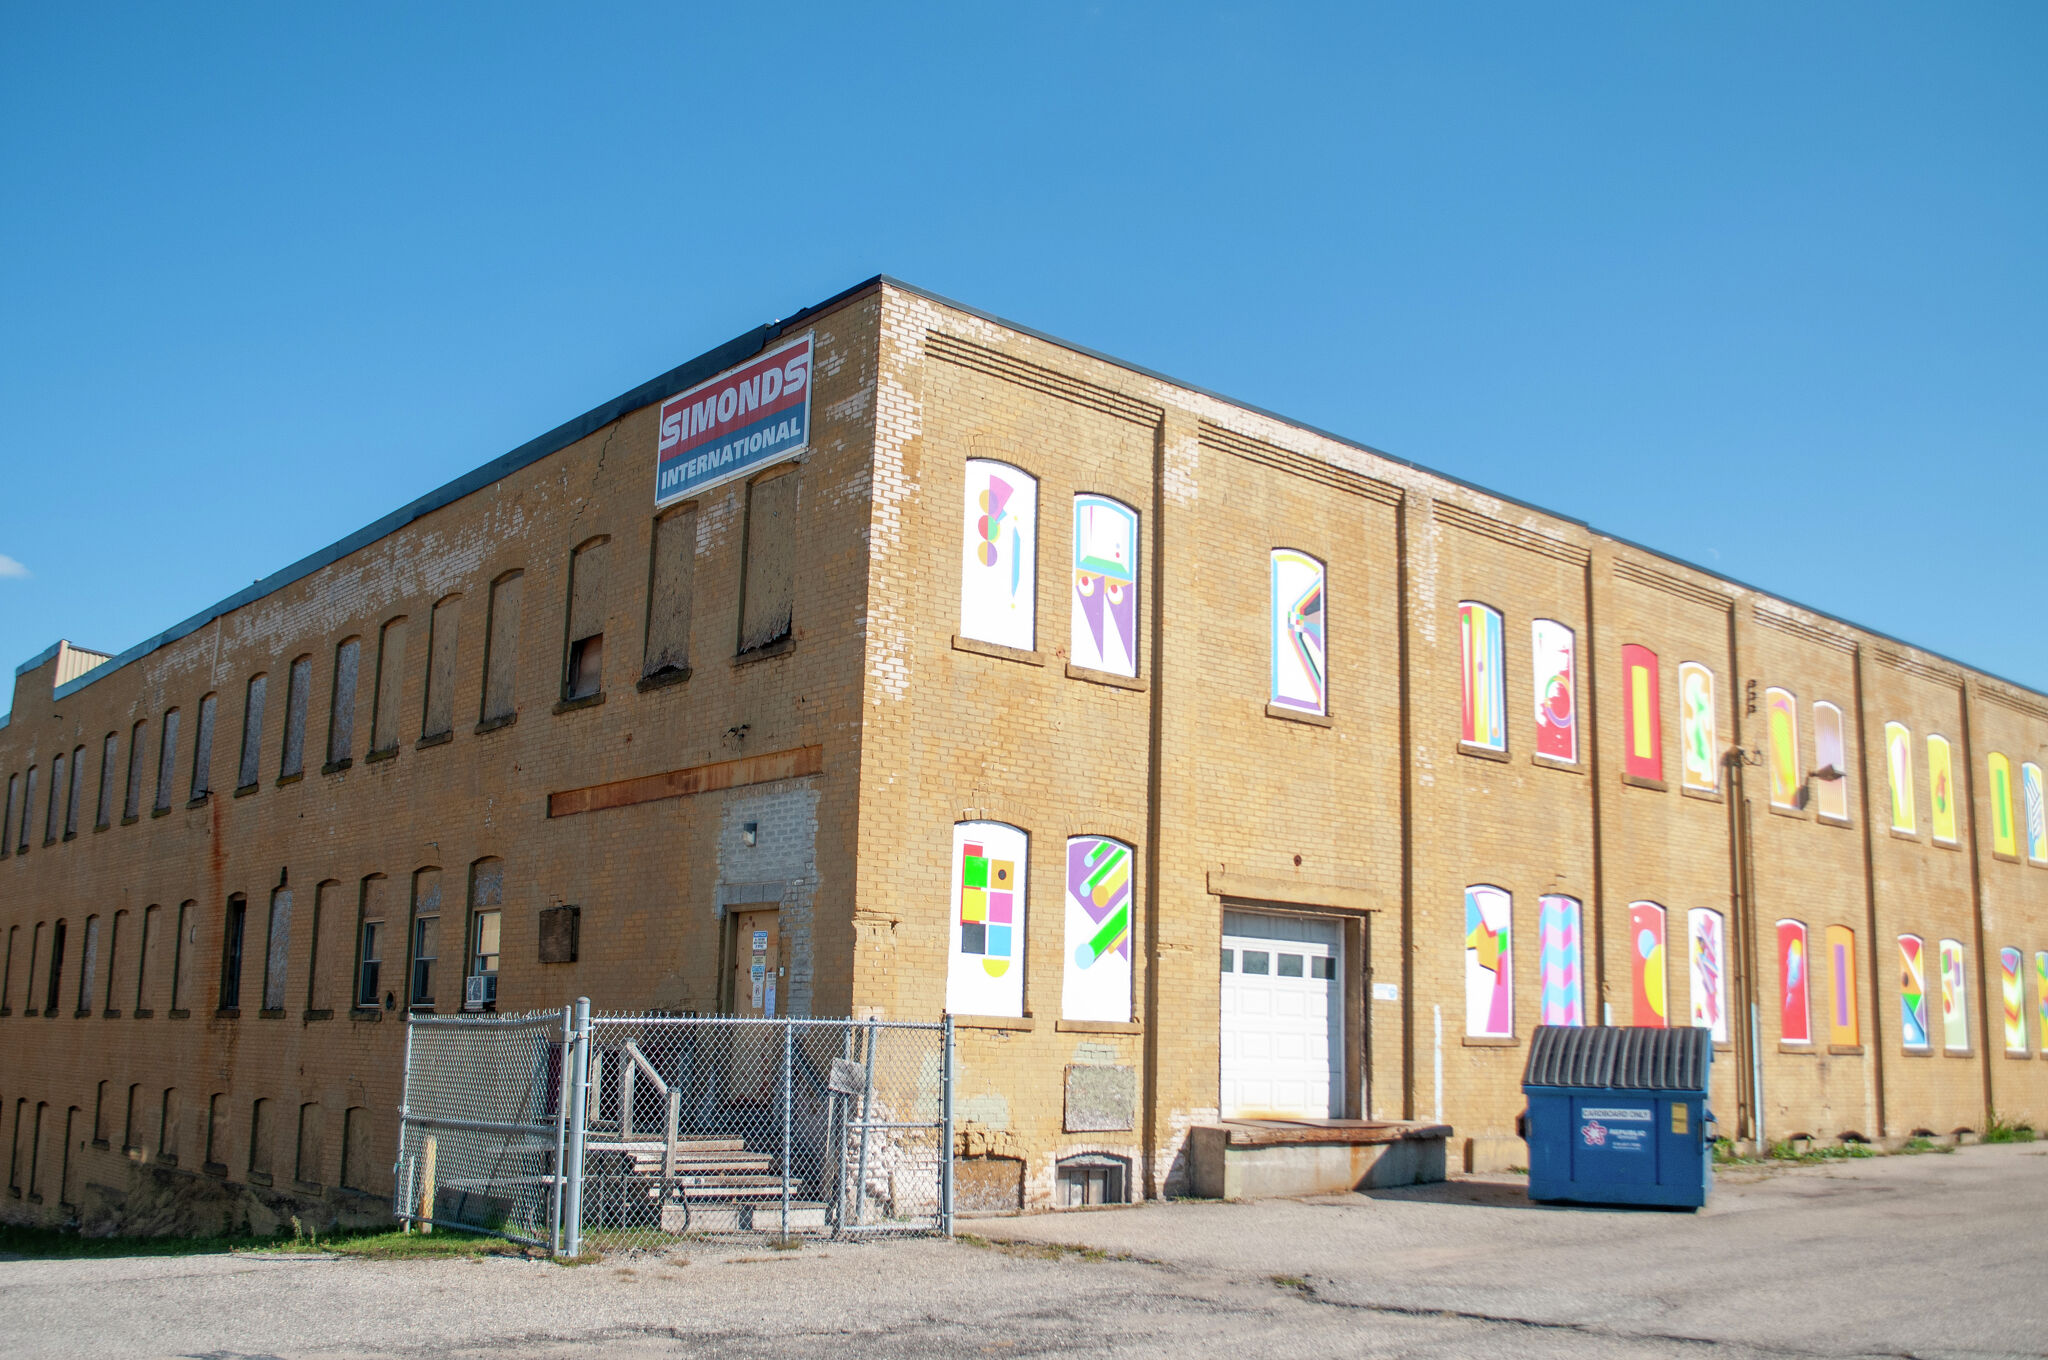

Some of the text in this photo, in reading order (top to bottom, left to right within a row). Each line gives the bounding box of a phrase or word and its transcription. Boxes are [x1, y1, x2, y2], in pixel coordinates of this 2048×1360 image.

[661, 353, 809, 451] SIMONDS
[661, 418, 801, 490] INTERNATIONAL
[1583, 1110, 1648, 1119] CARDBOARD ONLY
